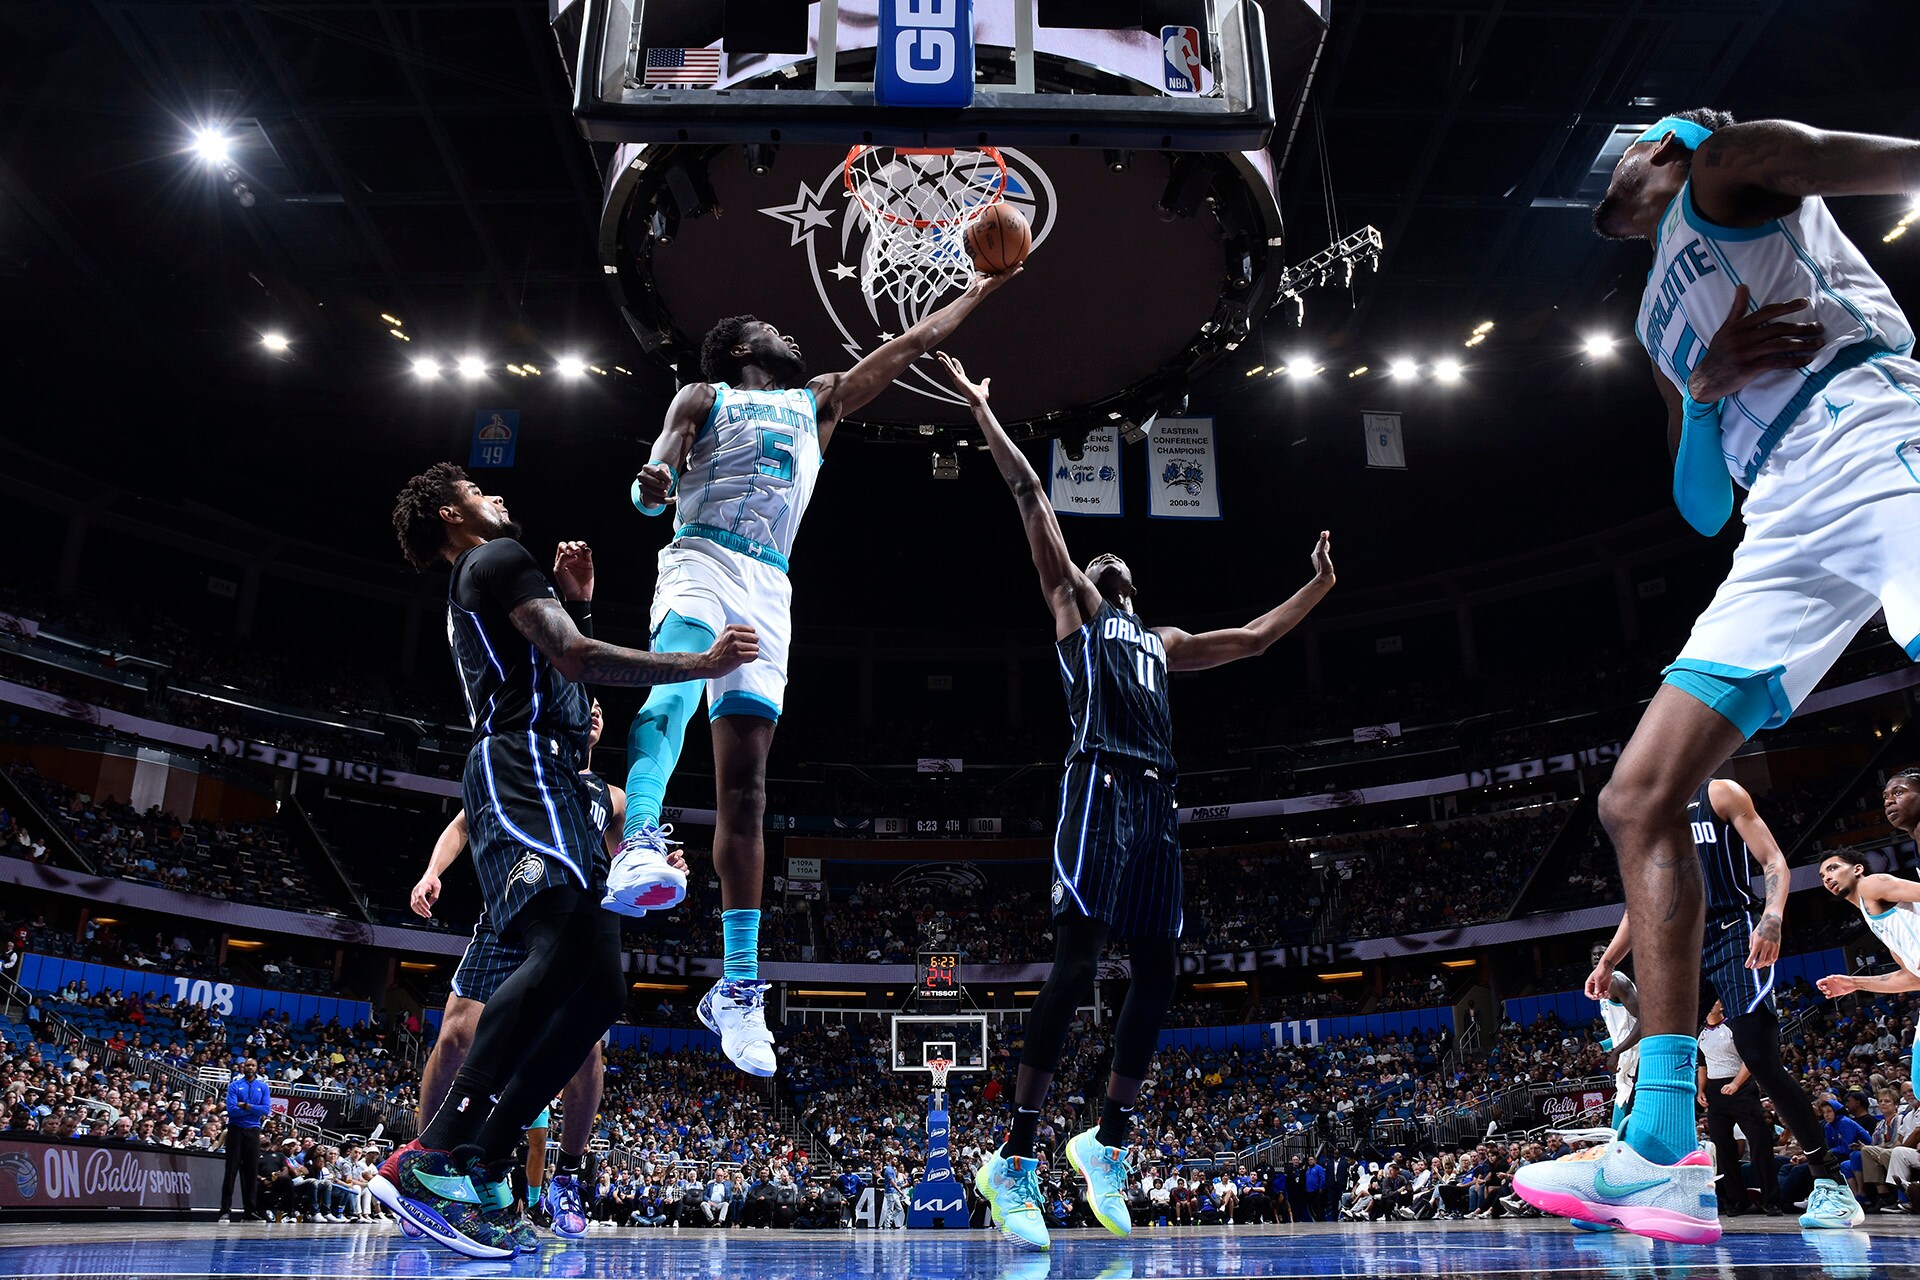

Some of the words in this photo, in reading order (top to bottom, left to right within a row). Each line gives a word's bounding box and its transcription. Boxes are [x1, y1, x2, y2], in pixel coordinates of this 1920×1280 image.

[895, 0, 956, 84] GE
[1169, 78, 1188, 89] NBA
[726, 403, 816, 438] CHARLOTTE
[1161, 427, 1199, 435] EASTERN
[1153, 437, 1208, 445] CONFERENCE
[1380, 435, 1387, 447] 6
[482, 446, 504, 464] 49
[759, 428, 794, 482] 5
[1157, 447, 1206, 455] CHAMPIONS
[1071, 496, 1100, 504] 1994-95
[1170, 499, 1200, 507] 2008-09
[1136, 649, 1156, 692] 11
[1191, 806, 1230, 820] MASSEY
[788, 816, 796, 828] 3
[885, 820, 897, 832] 69
[917, 820, 937, 832] 6:23
[945, 819, 960, 832] 4TH
[977, 819, 993, 832] 100
[930, 956, 955, 968] 6:23
[926, 967, 952, 987] 24
[174, 977, 235, 1017] 108
[1270, 1019, 1323, 1049] 111
[293, 1101, 328, 1122] Bally
[1542, 1097, 1577, 1116] Bally
[44, 1149, 81, 1199] ON
[85, 1149, 149, 1206] Bally
[150, 1170, 191, 1194] SPORTS
